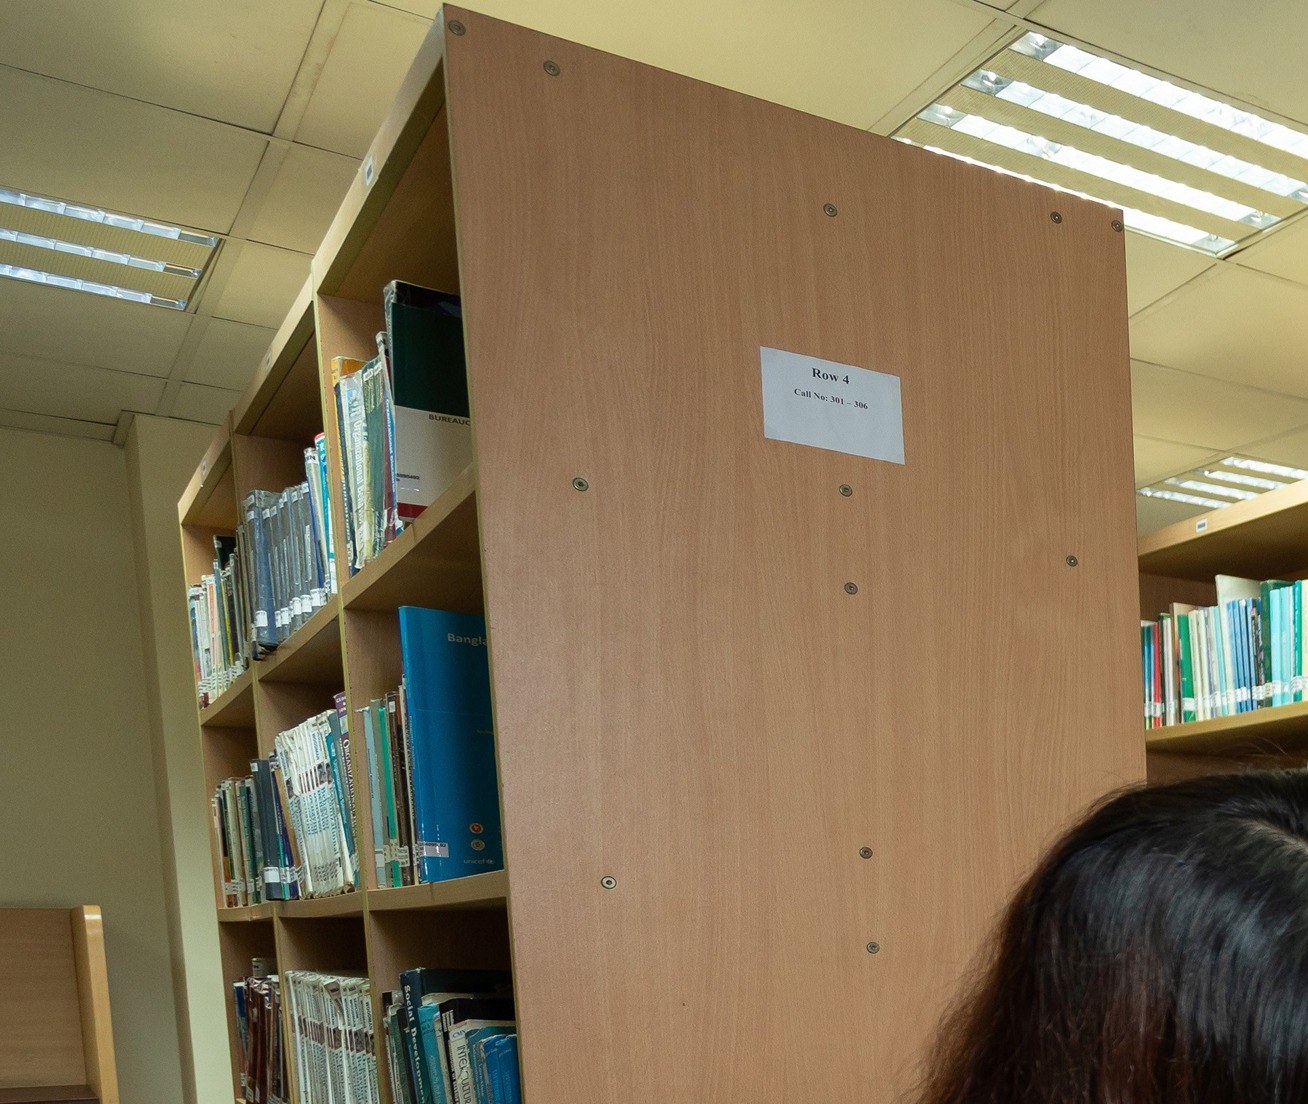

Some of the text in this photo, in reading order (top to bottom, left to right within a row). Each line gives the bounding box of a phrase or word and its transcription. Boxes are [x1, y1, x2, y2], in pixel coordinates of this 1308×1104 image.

[812, 368, 850, 384] Row 4
[794, 388, 868, 410] Call No: 301 306
[354, 419, 364, 484] Organizational
[404, 984, 415, 1024] Social
